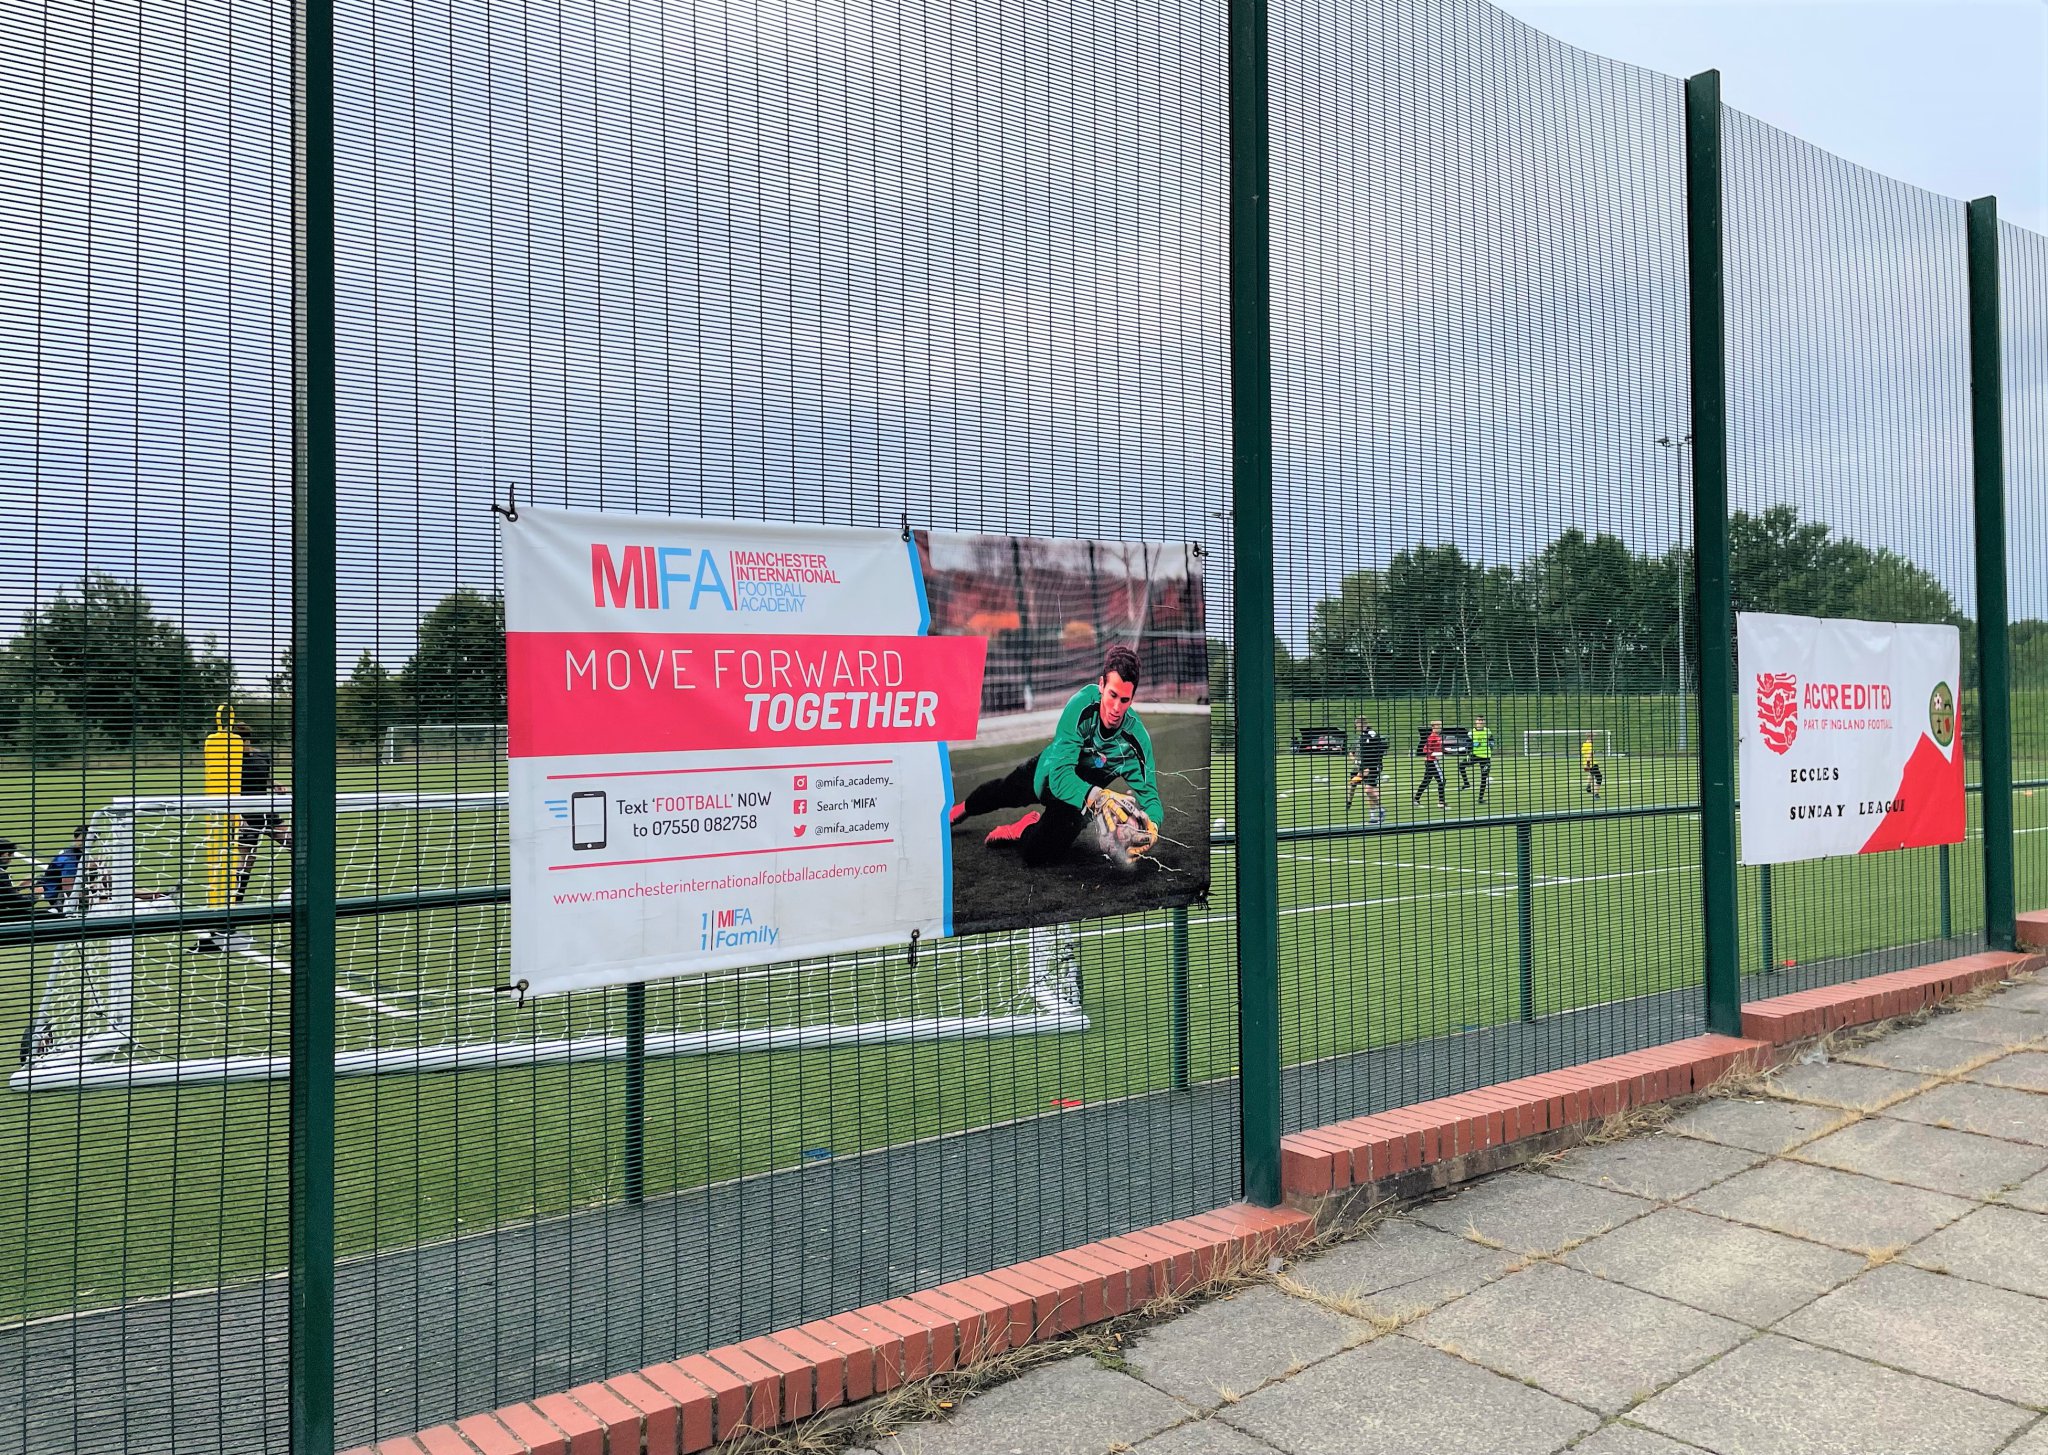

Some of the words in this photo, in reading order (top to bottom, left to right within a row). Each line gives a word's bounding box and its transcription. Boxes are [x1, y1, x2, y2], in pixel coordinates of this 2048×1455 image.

[735, 551, 827, 568] MANCHESTER
[591, 543, 734, 611] MIFA
[736, 566, 841, 584] INTERNATIONAL
[737, 581, 807, 597] FOOTBALL
[740, 597, 806, 612] ACADEMY
[565, 649, 696, 692] MOVE
[715, 649, 903, 690] FORWARD
[744, 690, 939, 732] TOGETHER
[1803, 719, 1819, 731] PART
[1821, 719, 1828, 730] OF
[815, 774, 894, 790] @mifa_academy_
[1790, 767, 1839, 783] ECCLES
[616, 799, 648, 815] Text
[738, 791, 772, 807] NOW
[817, 799, 849, 812] Search
[1790, 804, 1846, 820] SUNDAY
[633, 823, 648, 837] to
[652, 818, 699, 836] 07550
[704, 814, 757, 832] 082758
[815, 820, 890, 836] @mifa_academy
[553, 861, 888, 905] www.manchesterinternationalfootballacademy.com
[717, 907, 753, 929] MIFA
[716, 925, 779, 949] Family
